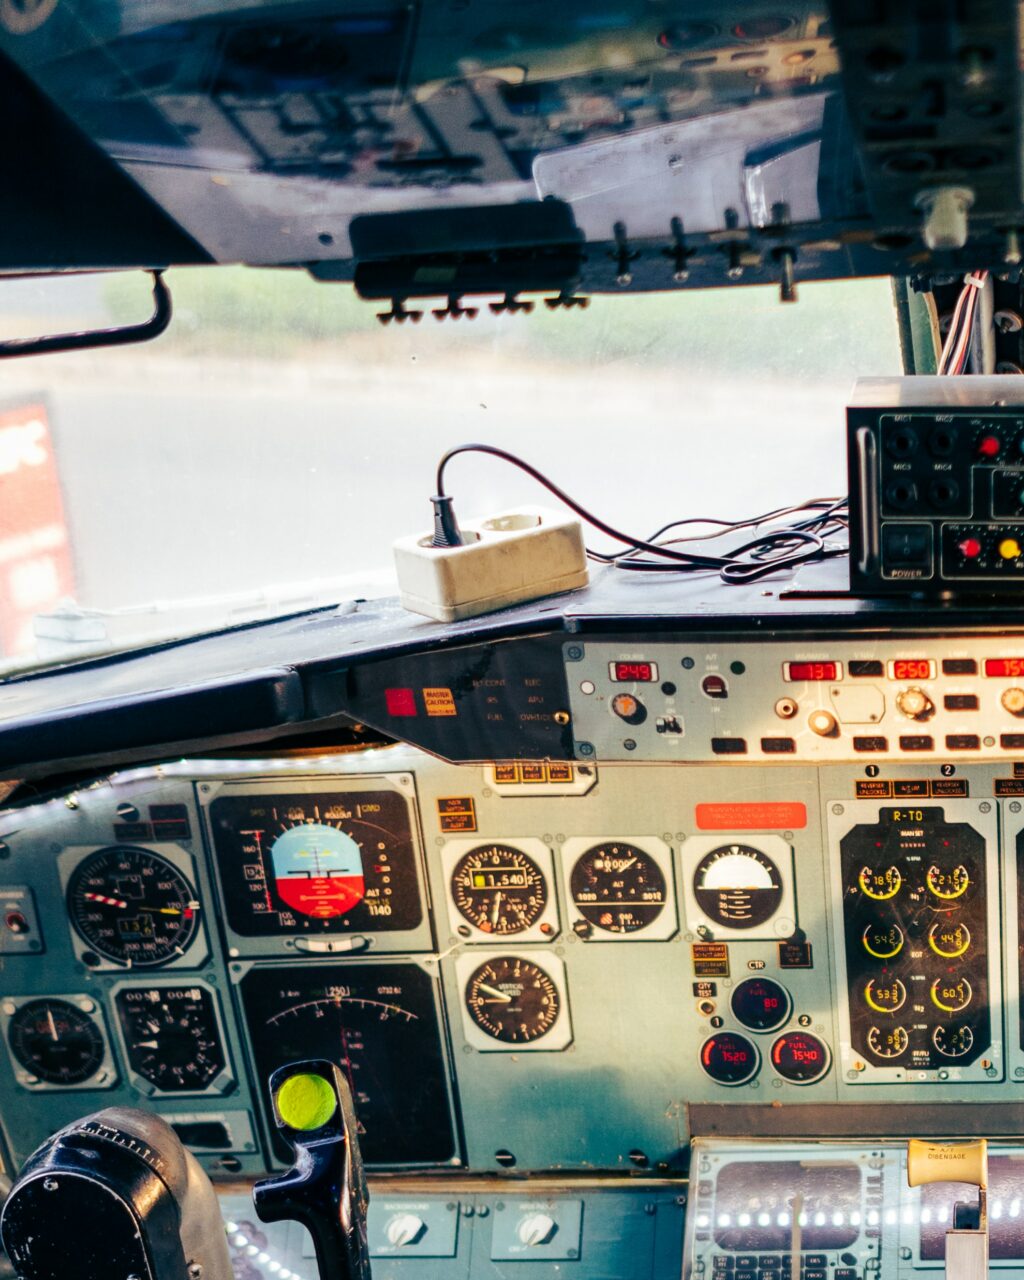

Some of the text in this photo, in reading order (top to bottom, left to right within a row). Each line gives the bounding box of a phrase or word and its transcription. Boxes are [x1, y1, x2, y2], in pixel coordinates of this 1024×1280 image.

[891, 570, 922, 578] POWER
[618, 665, 649, 679] 249
[807, 665, 834, 679] 137
[898, 663, 929, 677] 250
[367, 889, 380, 897] ALT
[370, 906, 391, 915] 1140
[722, 1052, 746, 1061] 1520
[792, 1050, 817, 1060] 1540
